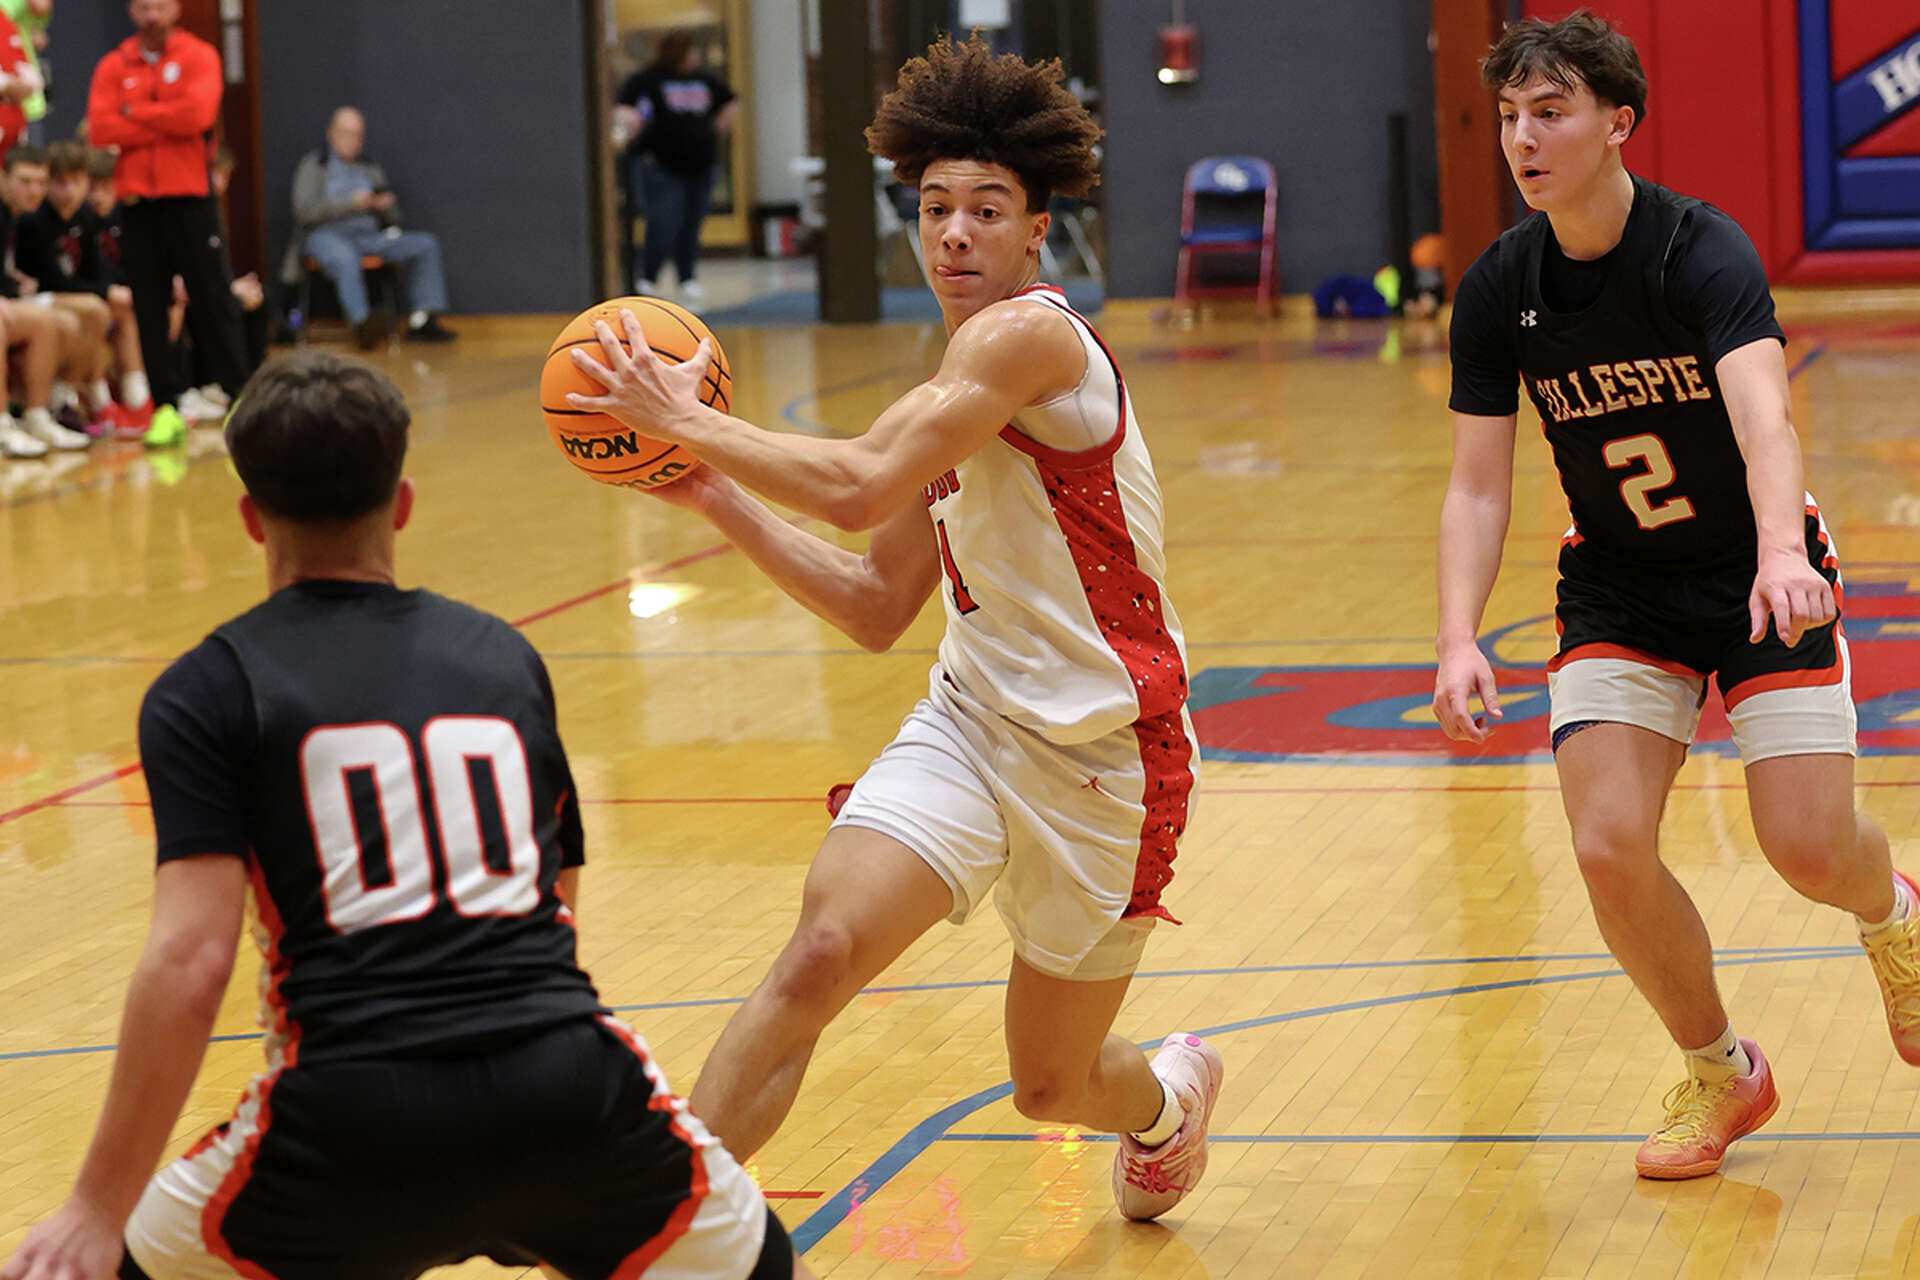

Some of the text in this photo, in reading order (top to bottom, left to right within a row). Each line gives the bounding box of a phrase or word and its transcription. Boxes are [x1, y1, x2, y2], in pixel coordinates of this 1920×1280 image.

[560, 431, 639, 459] NCAA
[1602, 433, 1696, 530] 2
[298, 713, 542, 936] 00
